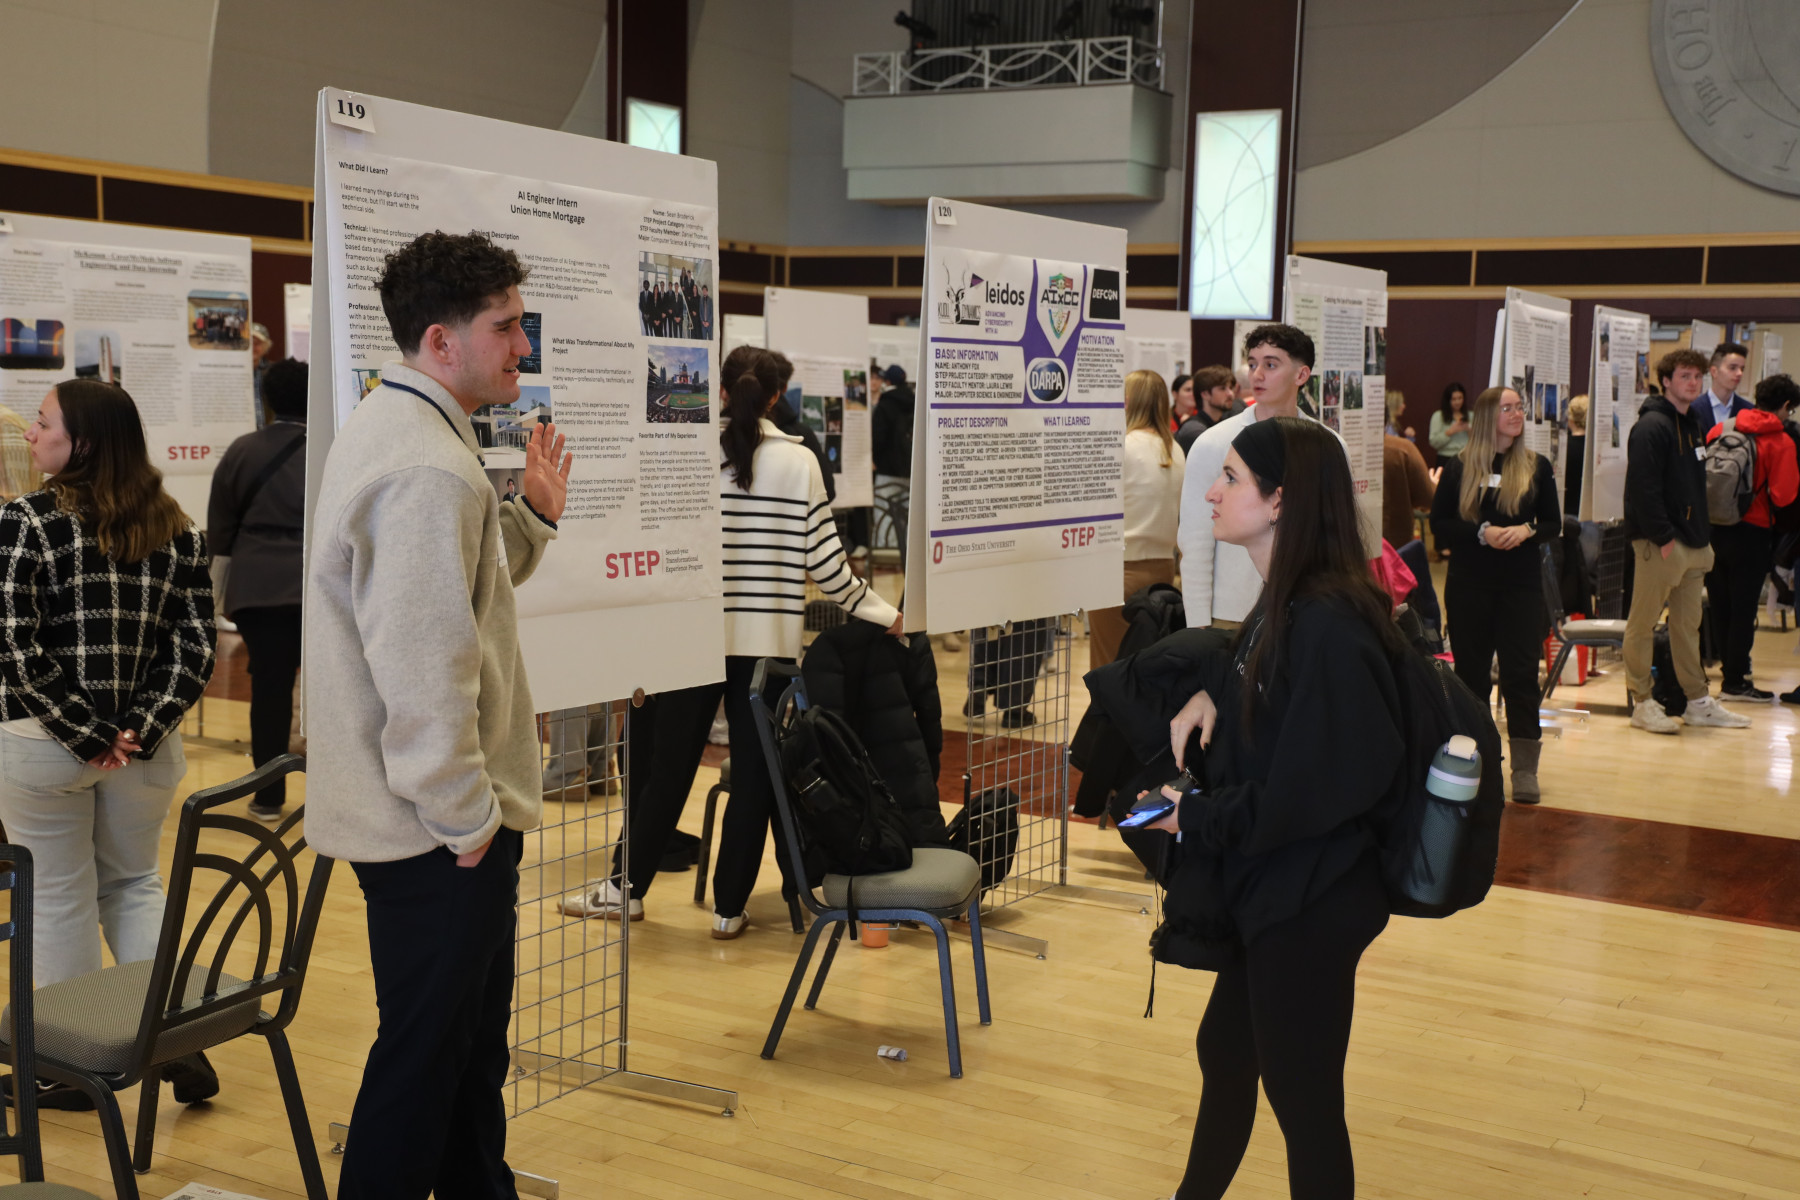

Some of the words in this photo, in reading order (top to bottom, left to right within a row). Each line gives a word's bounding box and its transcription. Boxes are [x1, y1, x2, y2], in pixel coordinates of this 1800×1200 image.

[337, 100, 365, 119] 119
[339, 161, 354, 170] What
[355, 163, 365, 172] Did
[369, 166, 388, 175] Learn?
[343, 183, 361, 193] learned
[377, 189, 392, 197] things
[393, 191, 409, 200] during
[342, 194, 368, 203] experience,
[386, 199, 398, 208] start
[399, 200, 410, 209] with
[518, 191, 525, 200] AI
[527, 192, 555, 204] Engineer
[557, 197, 578, 208] Intern
[342, 203, 364, 212] technical
[364, 205, 375, 214] side.
[510, 204, 531, 216] Union
[533, 208, 551, 219] Home
[553, 211, 585, 224] Mortgage
[938, 206, 951, 217] 120
[343, 223, 368, 232] Technical:
[372, 226, 388, 235] learned
[389, 229, 418, 238] professional
[491, 231, 519, 240] Description
[649, 226, 662, 234] Faculty
[344, 233, 366, 242] software
[367, 237, 394, 246] engineering
[688, 241, 710, 250] Engineering
[345, 253, 375, 262] frameworks
[347, 273, 376, 282] automation
[985, 280, 1024, 306] leidos
[1092, 288, 1118, 300] DEFCON
[348, 303, 381, 312] Professional:
[349, 322, 365, 330] thrive
[576, 339, 613, 347] Transformational
[1081, 335, 1114, 345] MOTIVATION
[935, 348, 956, 359] BASIC
[957, 350, 998, 360] INFORMATION
[1032, 371, 1063, 390] DARPA
[938, 417, 967, 428] PROJECT
[969, 417, 1008, 427] DESCRIPTION
[1043, 416, 1060, 426] WHAT
[1064, 416, 1090, 426] LEARNED
[168, 445, 210, 460] STEP
[1061, 526, 1095, 548] STEP
[605, 550, 660, 579] STEP
[665, 564, 689, 573] Experience
